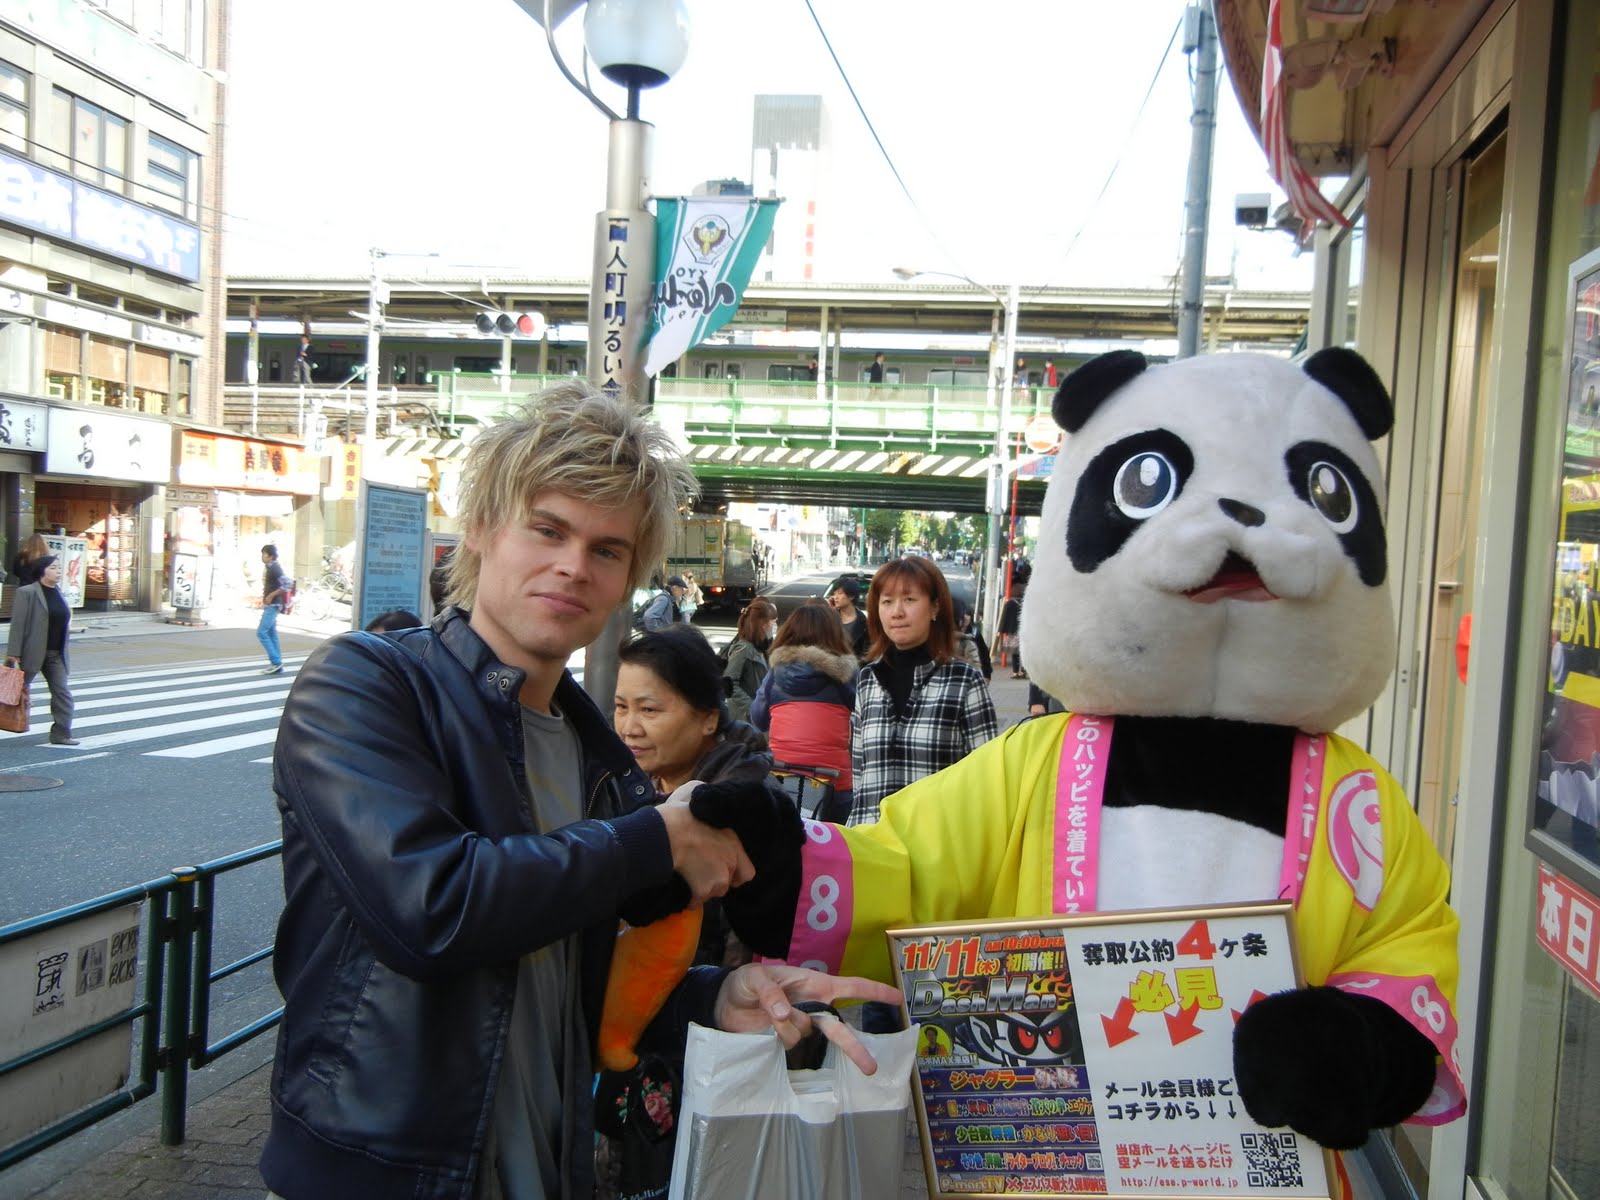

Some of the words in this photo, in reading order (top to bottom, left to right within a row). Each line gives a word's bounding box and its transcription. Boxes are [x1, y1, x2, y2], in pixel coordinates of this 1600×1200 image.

[807, 875, 839, 931] 8
[1540, 881, 1600, 981] 本日
[910, 975, 1057, 1017] DashMan
[1129, 966, 1224, 1014] 必見
[949, 1070, 1035, 1091] ジャグラー
[1105, 1078, 1241, 1099] メール会員様で
[1107, 1101, 1200, 1121] コチラから
[1116, 1143, 1232, 1156] 当店ホームページに
[1117, 1156, 1234, 1169] 空メールを送るだけ
